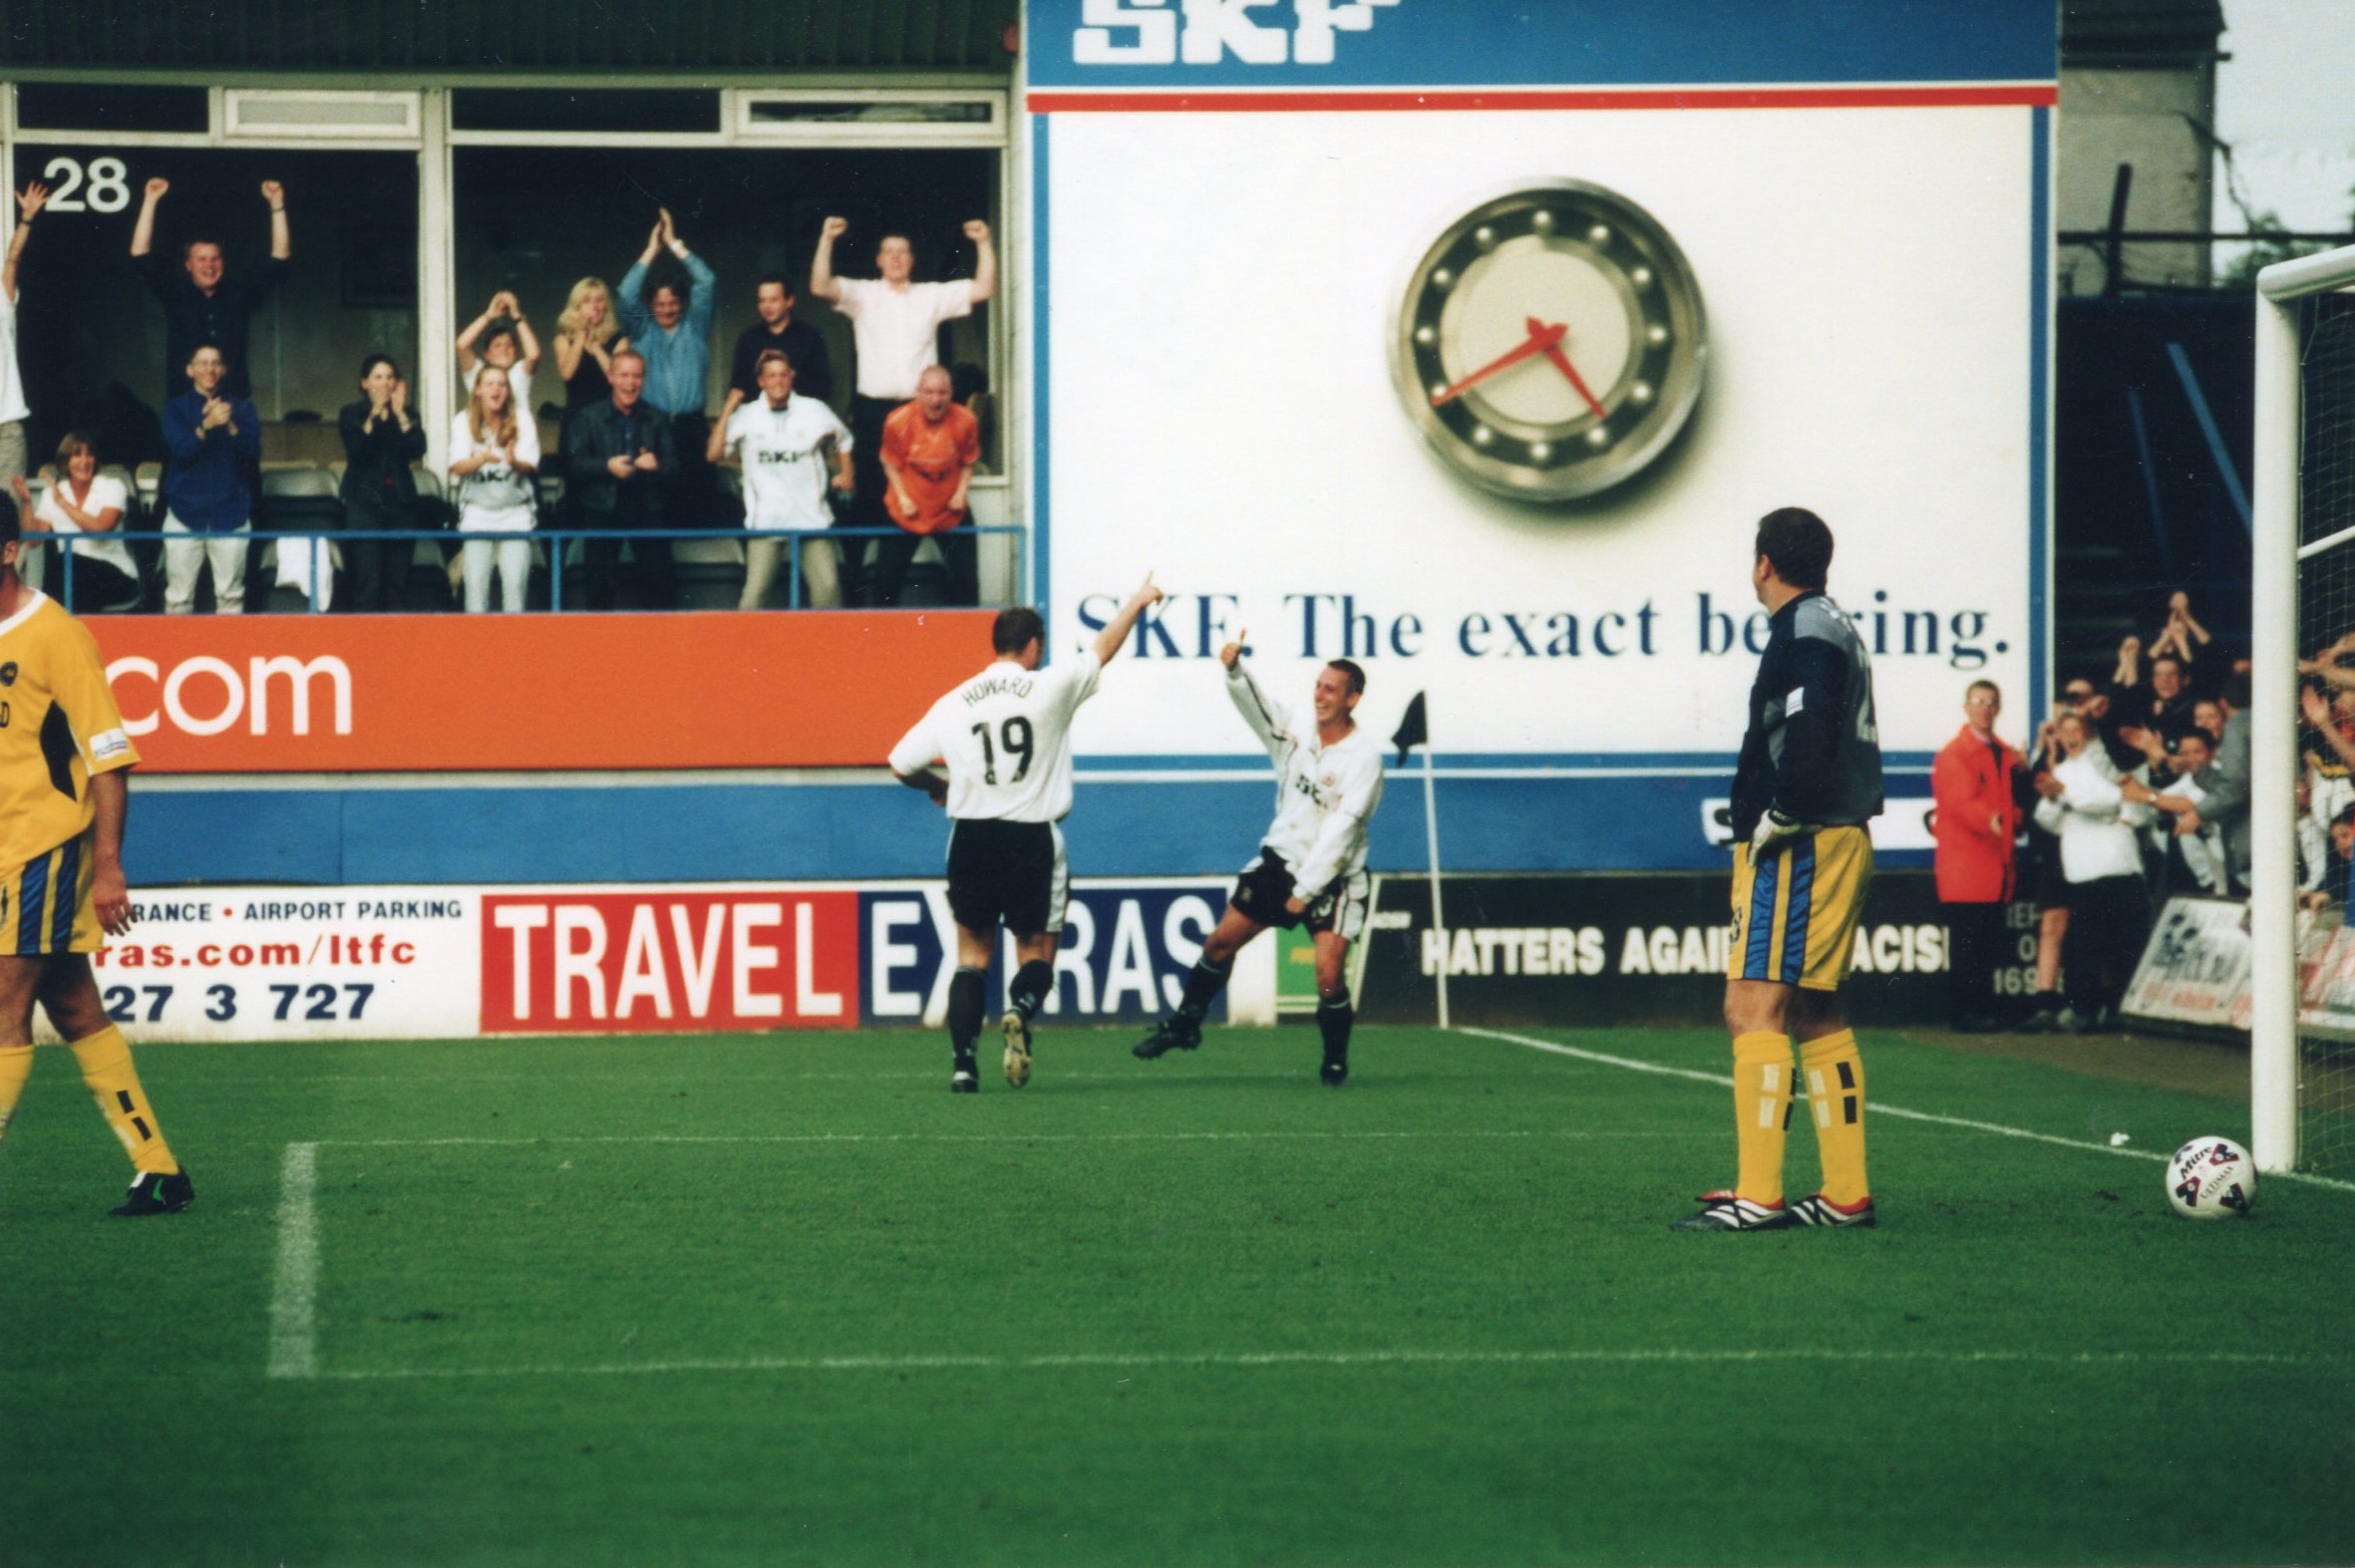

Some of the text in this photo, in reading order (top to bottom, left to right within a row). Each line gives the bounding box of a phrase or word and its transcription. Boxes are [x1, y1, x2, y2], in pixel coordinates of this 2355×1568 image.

[1073, 0, 1401, 65] SKF
[44, 157, 131, 212] 28
[1283, 593, 1424, 658] The
[1458, 597, 1660, 658] exact
[1695, 590, 2009, 671] being.
[962, 677, 1034, 708] HOWARD
[971, 715, 1035, 785] 19
[132, 899, 463, 922] RANCE AIRPORT PARKING
[95, 933, 416, 967] ras.com/ltfc
[494, 901, 843, 1020] TRAVEL
[1421, 926, 1606, 976] HATTERS
[1850, 924, 1949, 973] ACIS
[204, 983, 237, 1023] 3
[268, 983, 375, 1021] 727
[2180, 1146, 2212, 1181] Mitre
